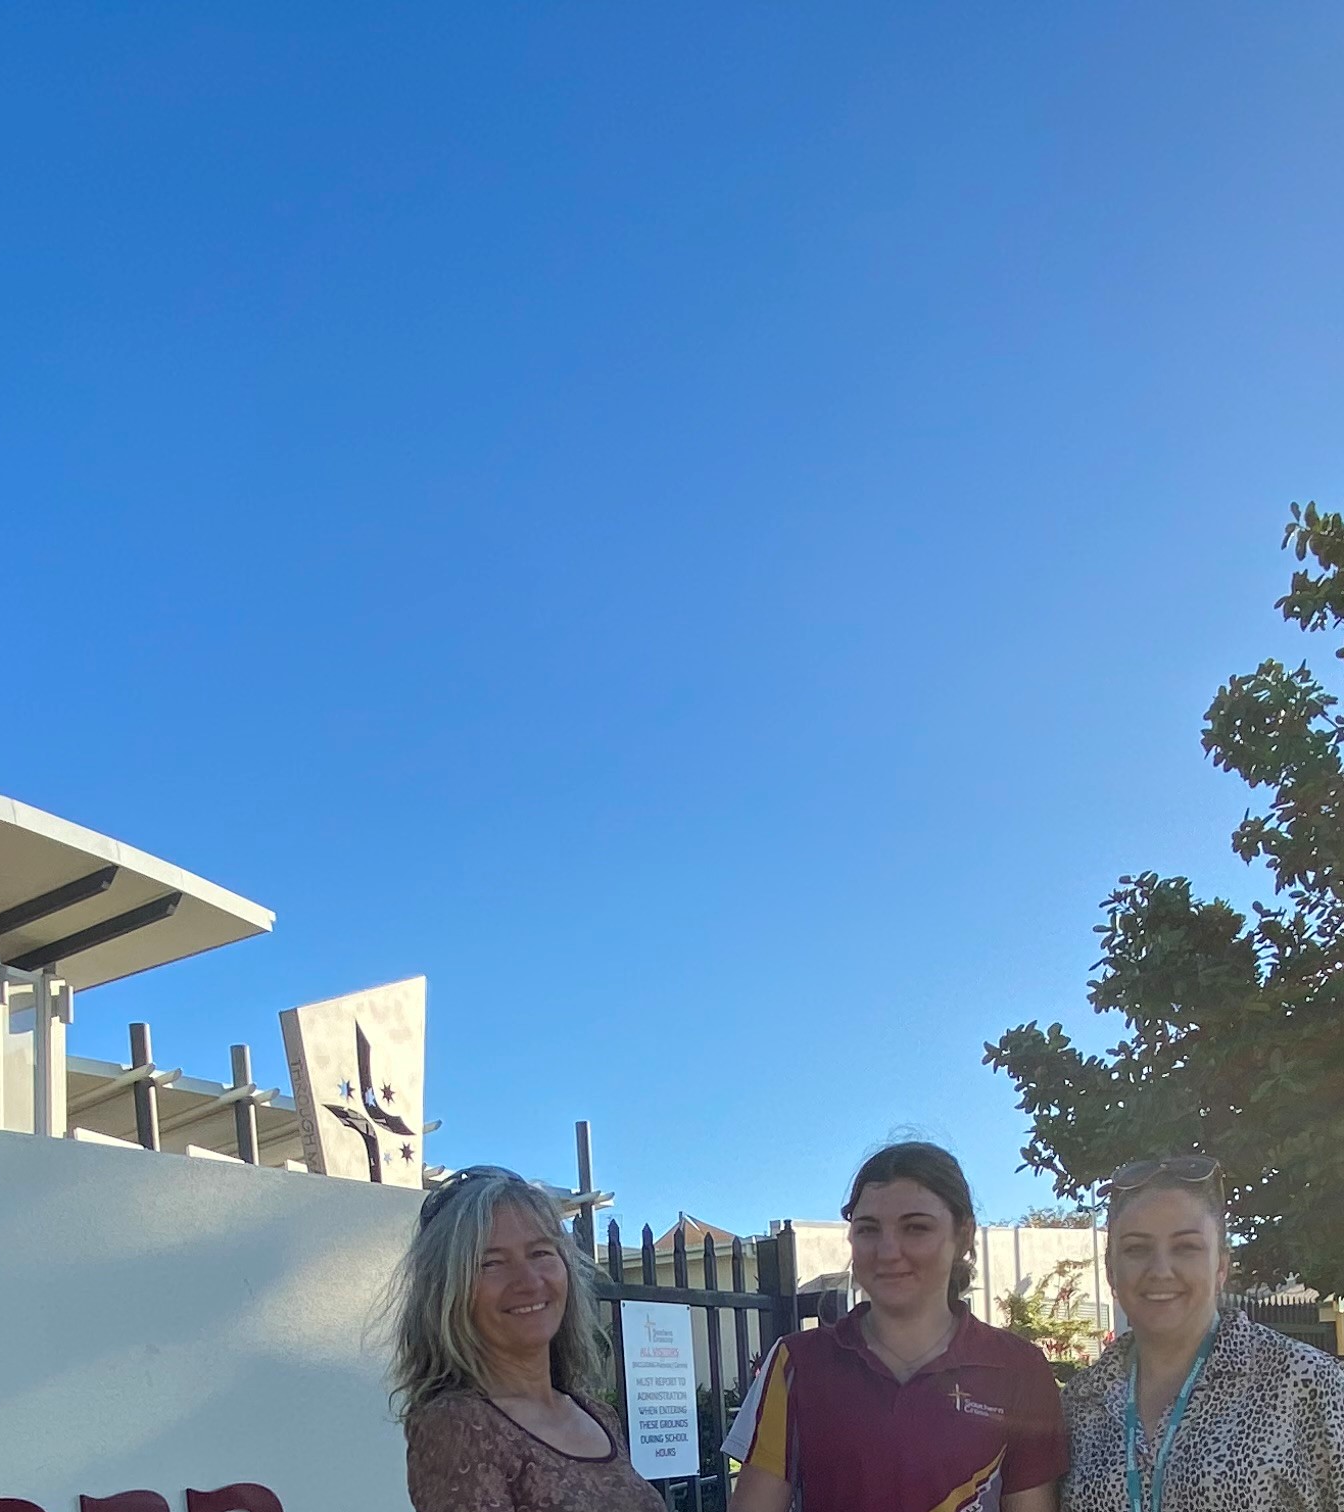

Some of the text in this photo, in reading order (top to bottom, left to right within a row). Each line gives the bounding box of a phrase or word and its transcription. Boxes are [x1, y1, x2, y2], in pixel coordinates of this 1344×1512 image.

[637, 1391, 688, 1401] ADMINISTRATION
[638, 1404, 688, 1415] WHEN ENTERING
[639, 1419, 689, 1430] THESE GROUNDS
[640, 1433, 689, 1445] DURING SCHOOL
[655, 1447, 677, 1458] HOURS
